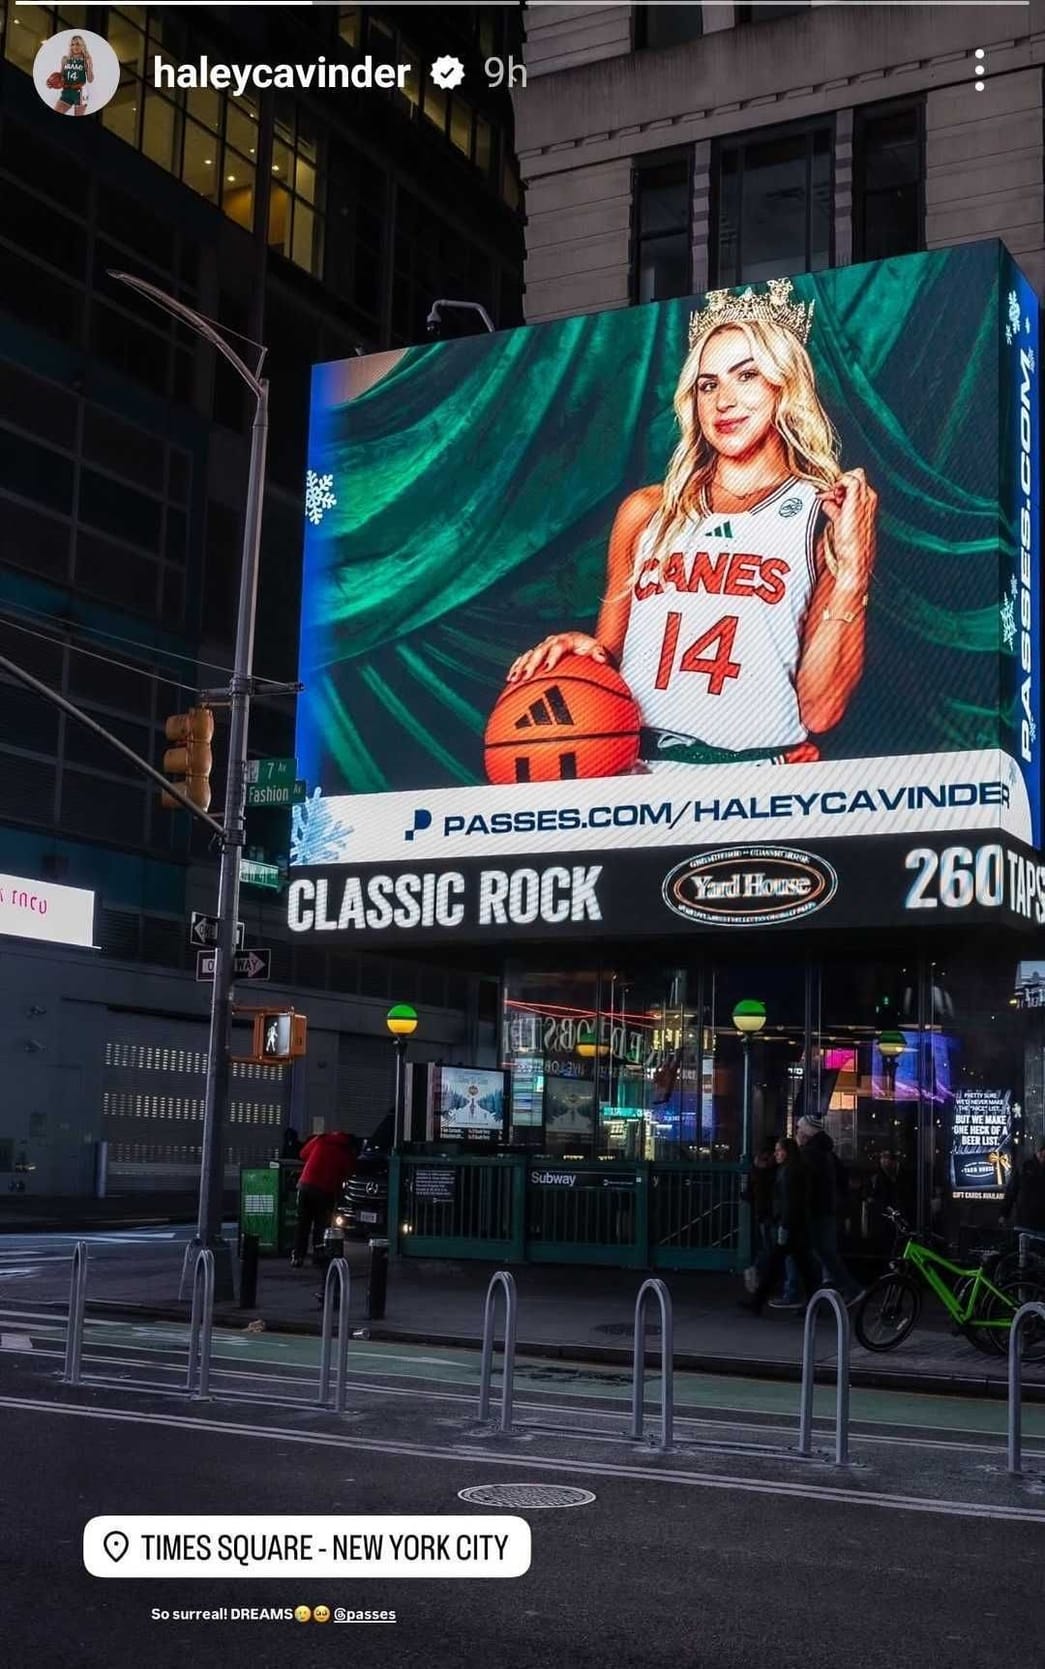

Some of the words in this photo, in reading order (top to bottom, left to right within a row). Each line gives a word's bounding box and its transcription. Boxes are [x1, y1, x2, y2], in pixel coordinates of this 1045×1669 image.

[1019, 347, 1032, 763] PASSES.COM
[634, 551, 792, 606] CANES
[654, 611, 742, 696] 14
[267, 762, 275, 780] 7
[249, 785, 290, 803] Fashion
[443, 781, 1011, 837] PASSES.COM/HALEYCAVINDER
[691, 873, 741, 900] Yard
[742, 872, 812, 898] House
[904, 844, 1004, 910] 260
[287, 870, 465, 933] CLASSIC
[478, 864, 604, 925] ROCK
[953, 1125, 969, 1135] ONE
[969, 1125, 990, 1135] HECK
[990, 1125, 1002, 1135] OF
[1002, 1126, 1008, 1136] A
[955, 1114, 970, 1124] BUT
[971, 1114, 984, 1124] WE
[984, 1114, 1007, 1125] MAKE
[961, 1135, 981, 1146] BEER
[981, 1135, 1000, 1146] LIST.
[531, 1171, 577, 1188] Subway
